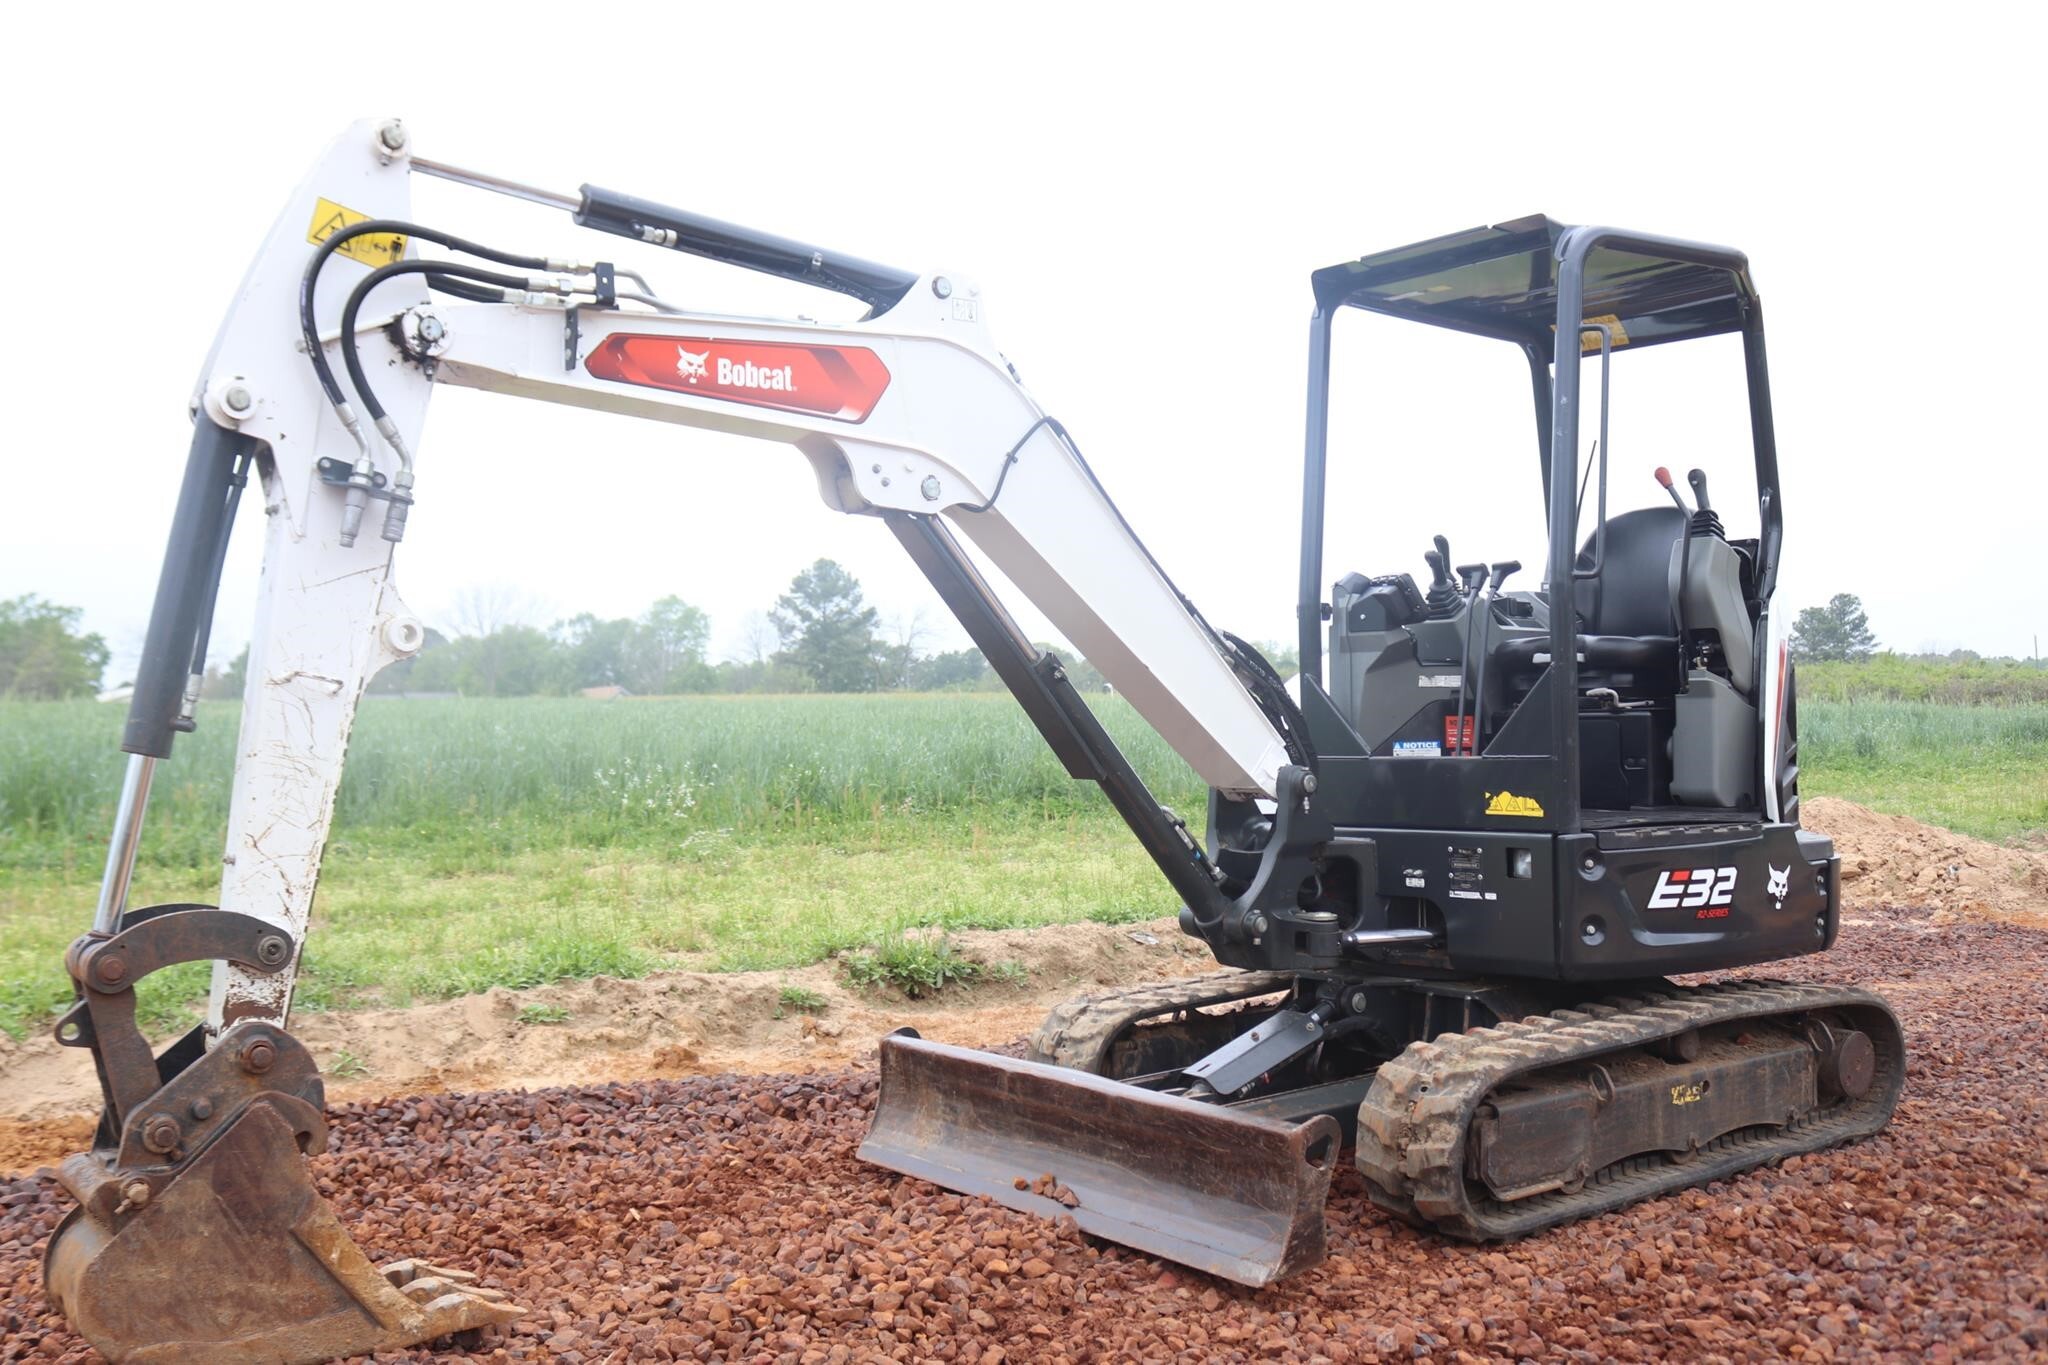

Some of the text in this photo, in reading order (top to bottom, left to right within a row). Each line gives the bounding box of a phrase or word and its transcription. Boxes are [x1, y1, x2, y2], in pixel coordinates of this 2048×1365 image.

[717, 357, 793, 392] Bobcat
[1403, 741, 1438, 749] NOTICE
[1647, 867, 1738, 909] E32
